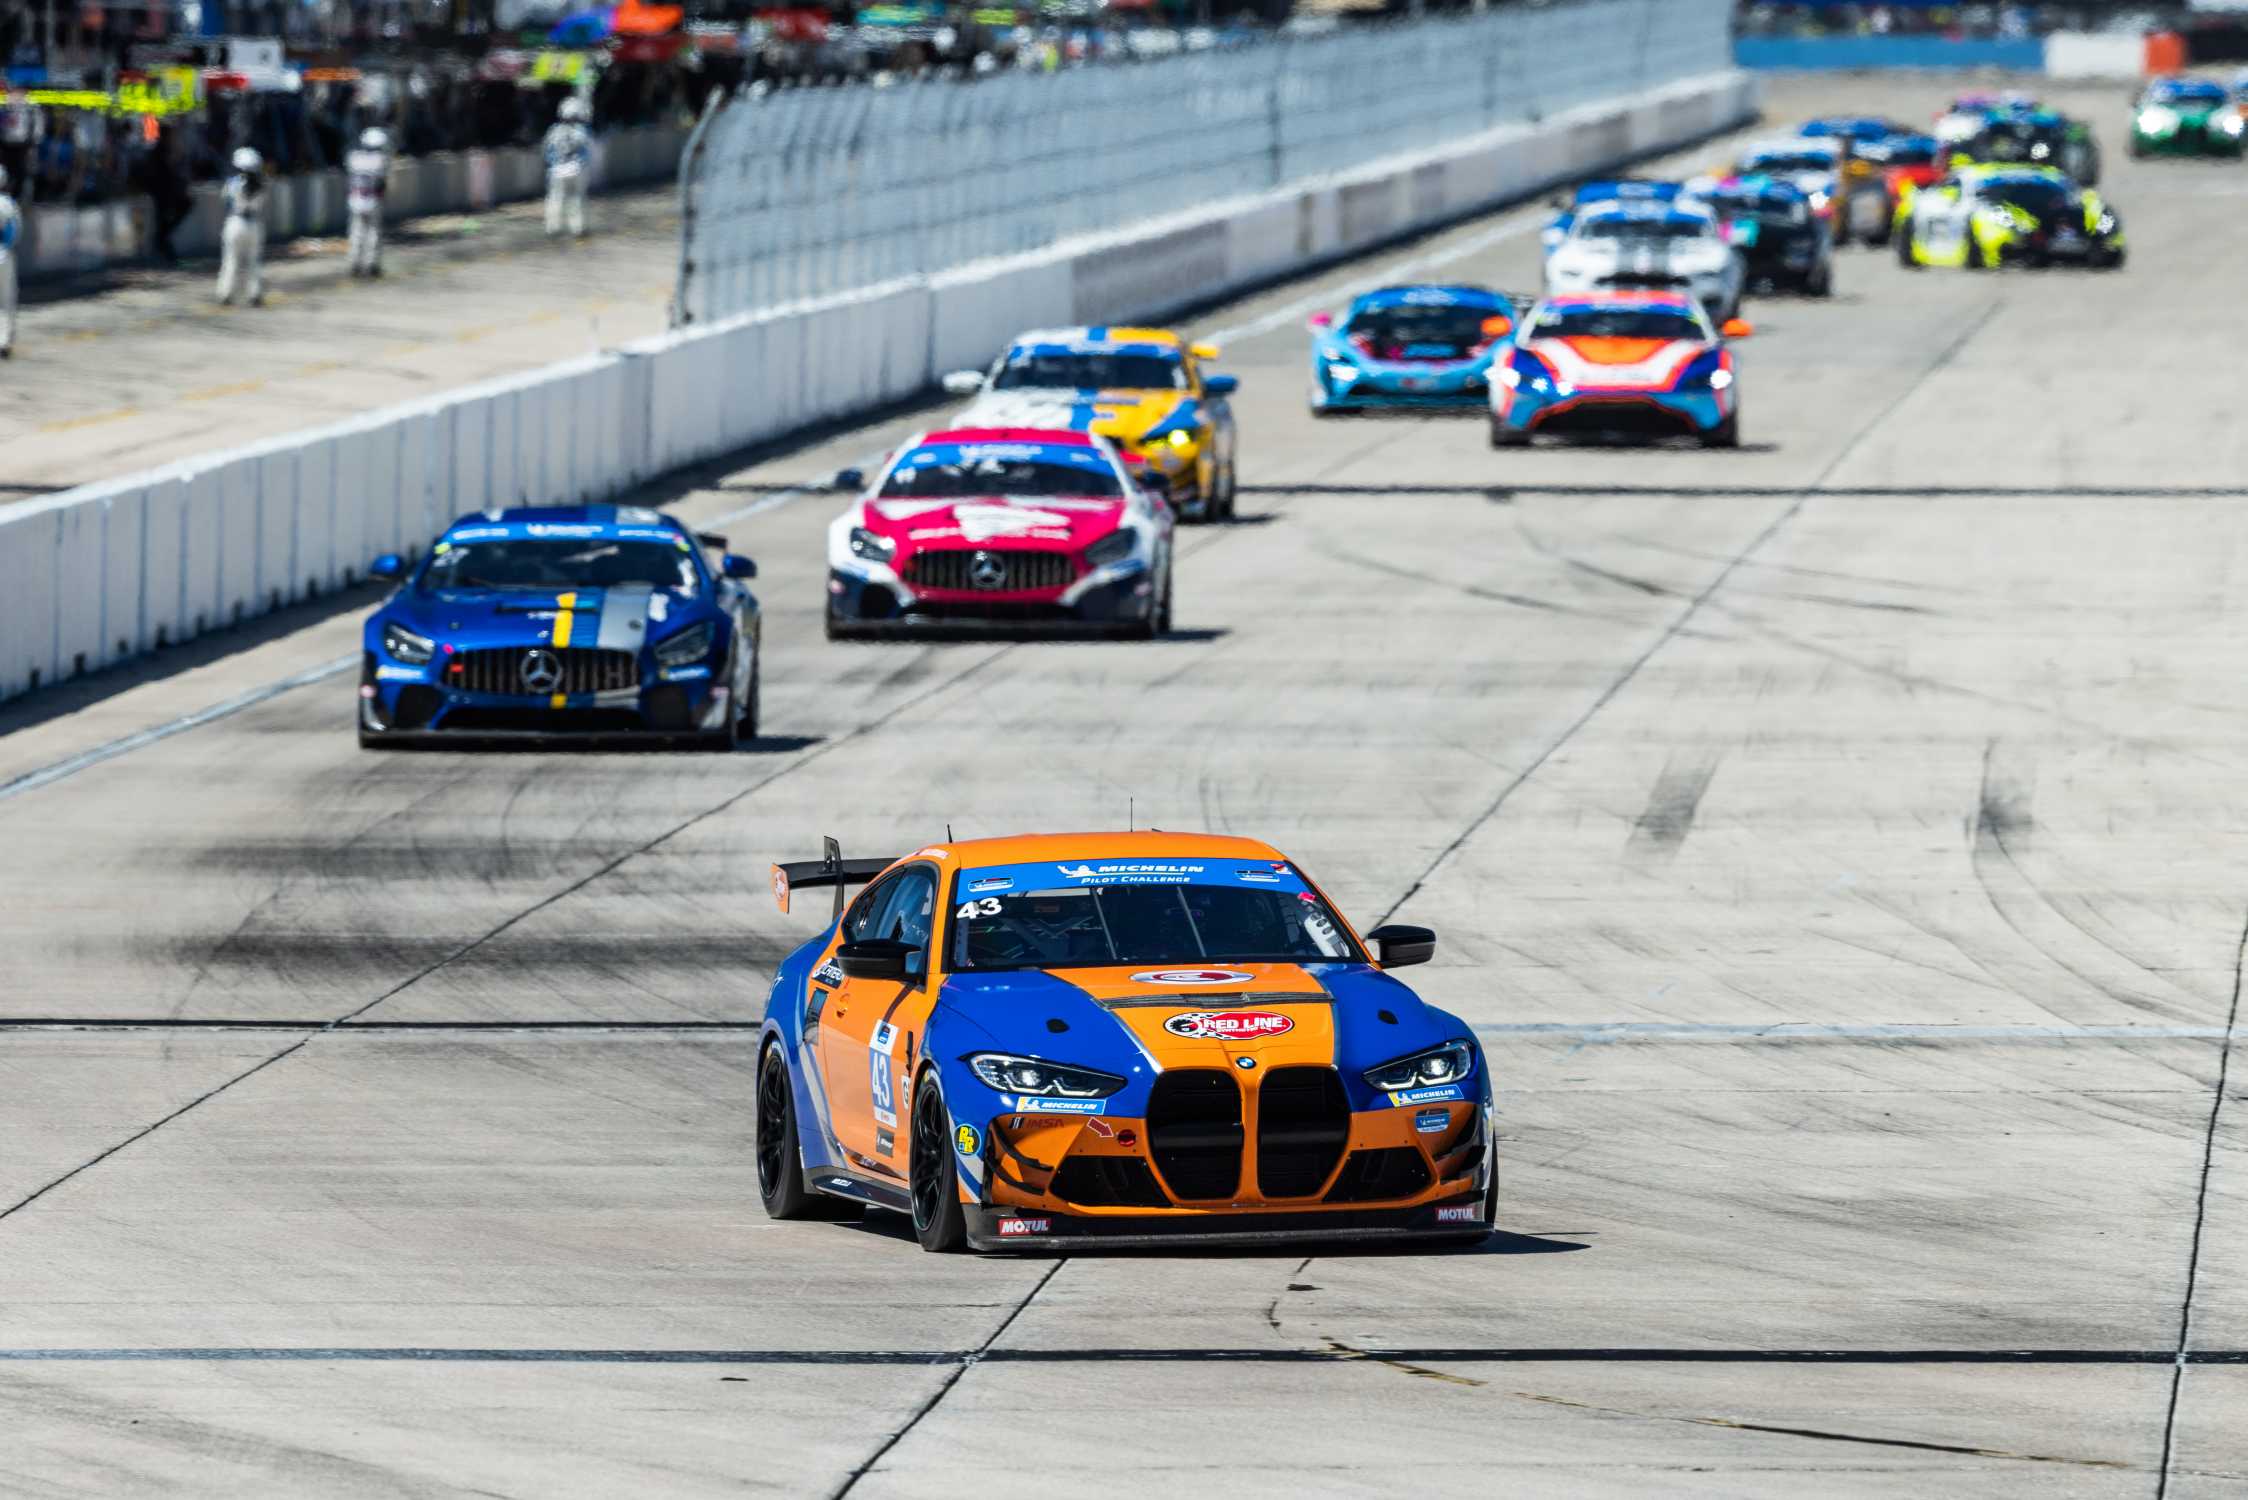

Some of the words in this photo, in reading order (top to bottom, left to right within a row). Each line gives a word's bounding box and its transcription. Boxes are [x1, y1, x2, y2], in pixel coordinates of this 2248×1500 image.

[1098, 865, 1204, 873] MICHELIN
[956, 897, 1002, 919] 43
[1203, 1018, 1240, 1030] RED
[1242, 1016, 1283, 1029] LINE
[872, 1051, 890, 1108] 43
[1411, 1089, 1455, 1100] MICHELIN
[1041, 1102, 1097, 1110] MICHELIN
[1438, 1208, 1474, 1221] MOTUL
[1001, 1219, 1049, 1233] MOTUL
